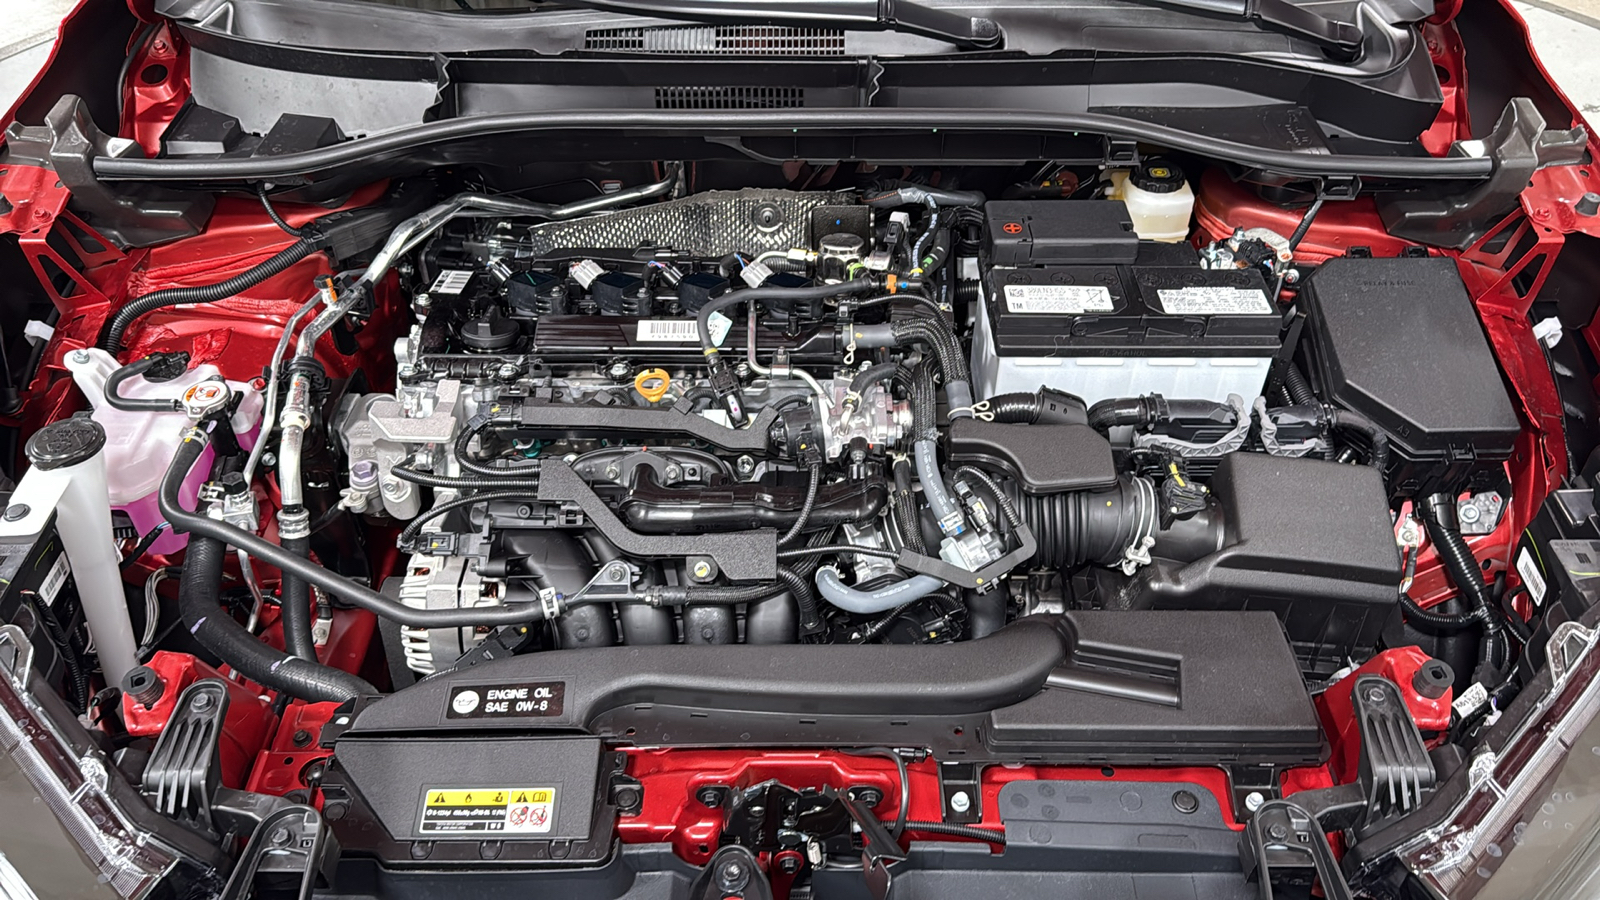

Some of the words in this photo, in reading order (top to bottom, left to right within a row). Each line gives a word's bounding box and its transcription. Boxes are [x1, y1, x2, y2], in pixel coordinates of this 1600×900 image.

[1012, 302, 1024, 310] TM
[486, 688, 528, 700] ENGINE
[534, 687, 553, 698] OIL
[484, 701, 509, 713] SAE
[515, 700, 548, 712] 0W-8
